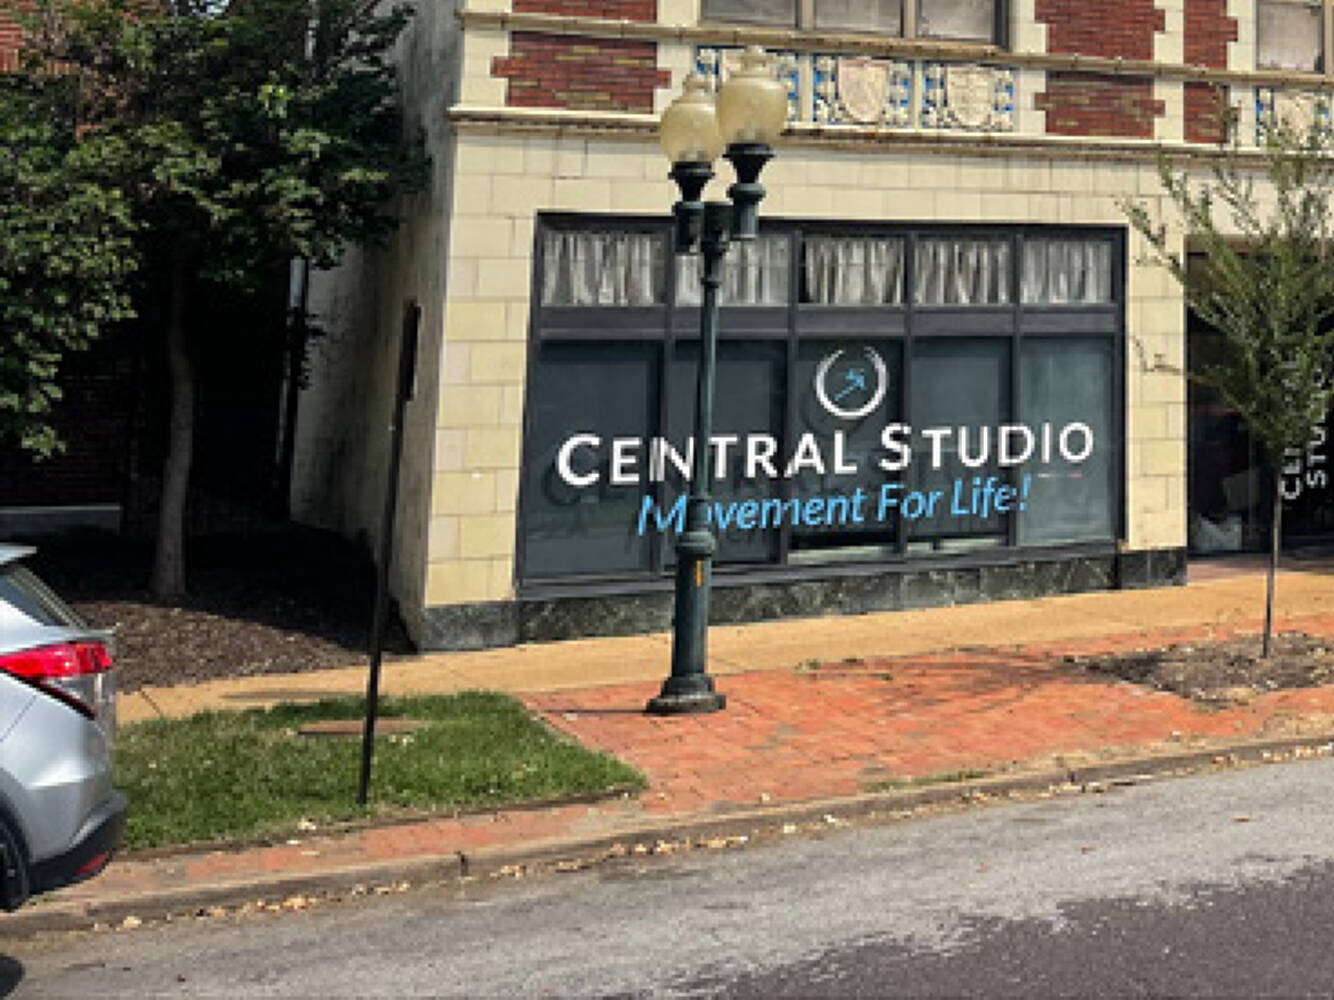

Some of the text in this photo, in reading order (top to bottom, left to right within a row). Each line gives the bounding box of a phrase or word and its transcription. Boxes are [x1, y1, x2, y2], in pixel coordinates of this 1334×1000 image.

[557, 421, 1094, 488] CENTRAL STUDIO
[637, 472, 1033, 537] Mvement For Life!
